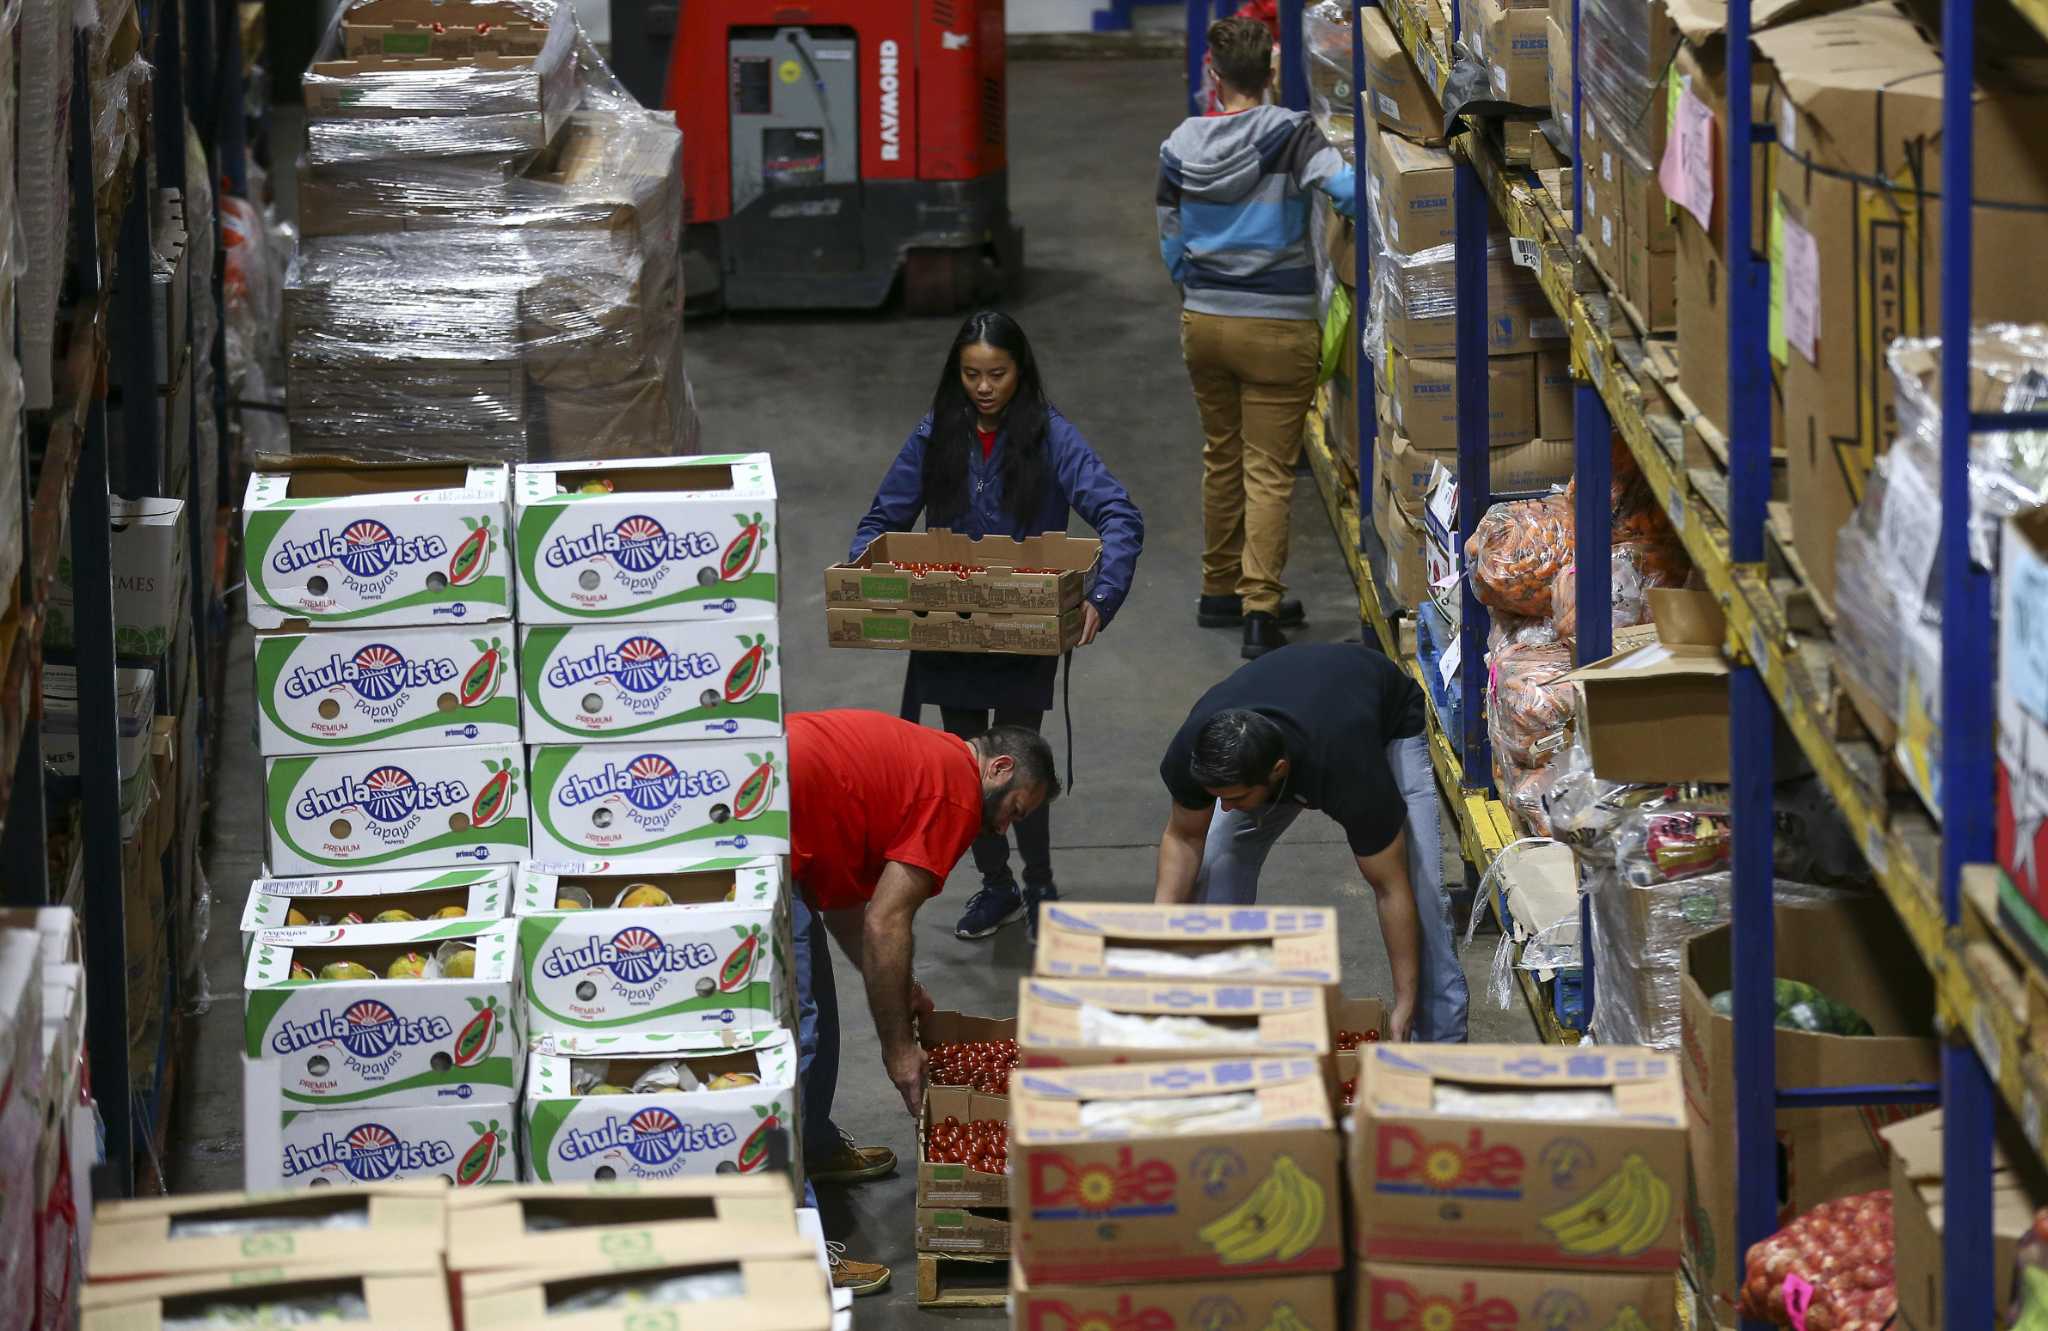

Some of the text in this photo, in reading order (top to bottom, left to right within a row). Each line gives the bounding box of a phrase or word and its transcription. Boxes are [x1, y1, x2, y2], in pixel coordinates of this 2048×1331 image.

[880, 40, 899, 161] RAYMOND
[273, 528, 448, 573] chula vista
[545, 523, 719, 568] chula vista
[112, 575, 155, 592] IMES
[299, 598, 336, 609] PREMIUM
[284, 654, 459, 699] chula vista
[547, 644, 721, 688] chula vista
[310, 722, 349, 732] PREMIUM
[47, 751, 75, 763] MES
[296, 775, 469, 820] chula vista
[558, 762, 730, 807] chula vista
[322, 843, 361, 853] PREMIUM
[542, 935, 717, 979] chula vista
[272, 1008, 453, 1055] chula vista
[299, 1078, 338, 1089] PREMIUM
[382, 1140, 454, 1169] vista
[558, 1117, 737, 1161] chula vista
[1375, 1126, 1525, 1189] Dole
[1027, 1147, 1178, 1210] Dole
[1370, 1279, 1519, 1331] Dole
